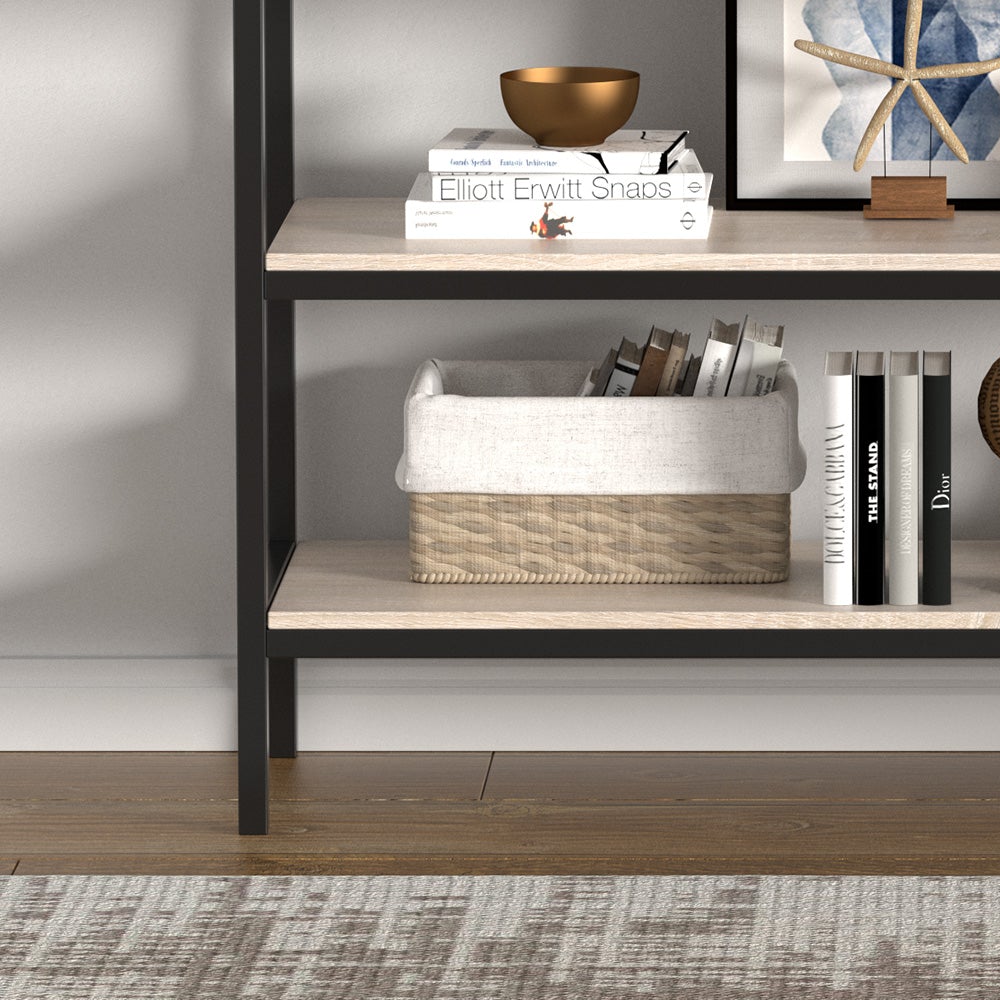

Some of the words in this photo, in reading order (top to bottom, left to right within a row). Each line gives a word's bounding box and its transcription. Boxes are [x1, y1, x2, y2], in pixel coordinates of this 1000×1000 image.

[440, 177, 505, 201] Elliott
[514, 177, 583, 200] Erwitt
[591, 176, 672, 200] Snaps
[868, 441, 878, 491] STAND
[930, 473, 951, 511] Dior
[868, 495, 878, 523] THE
